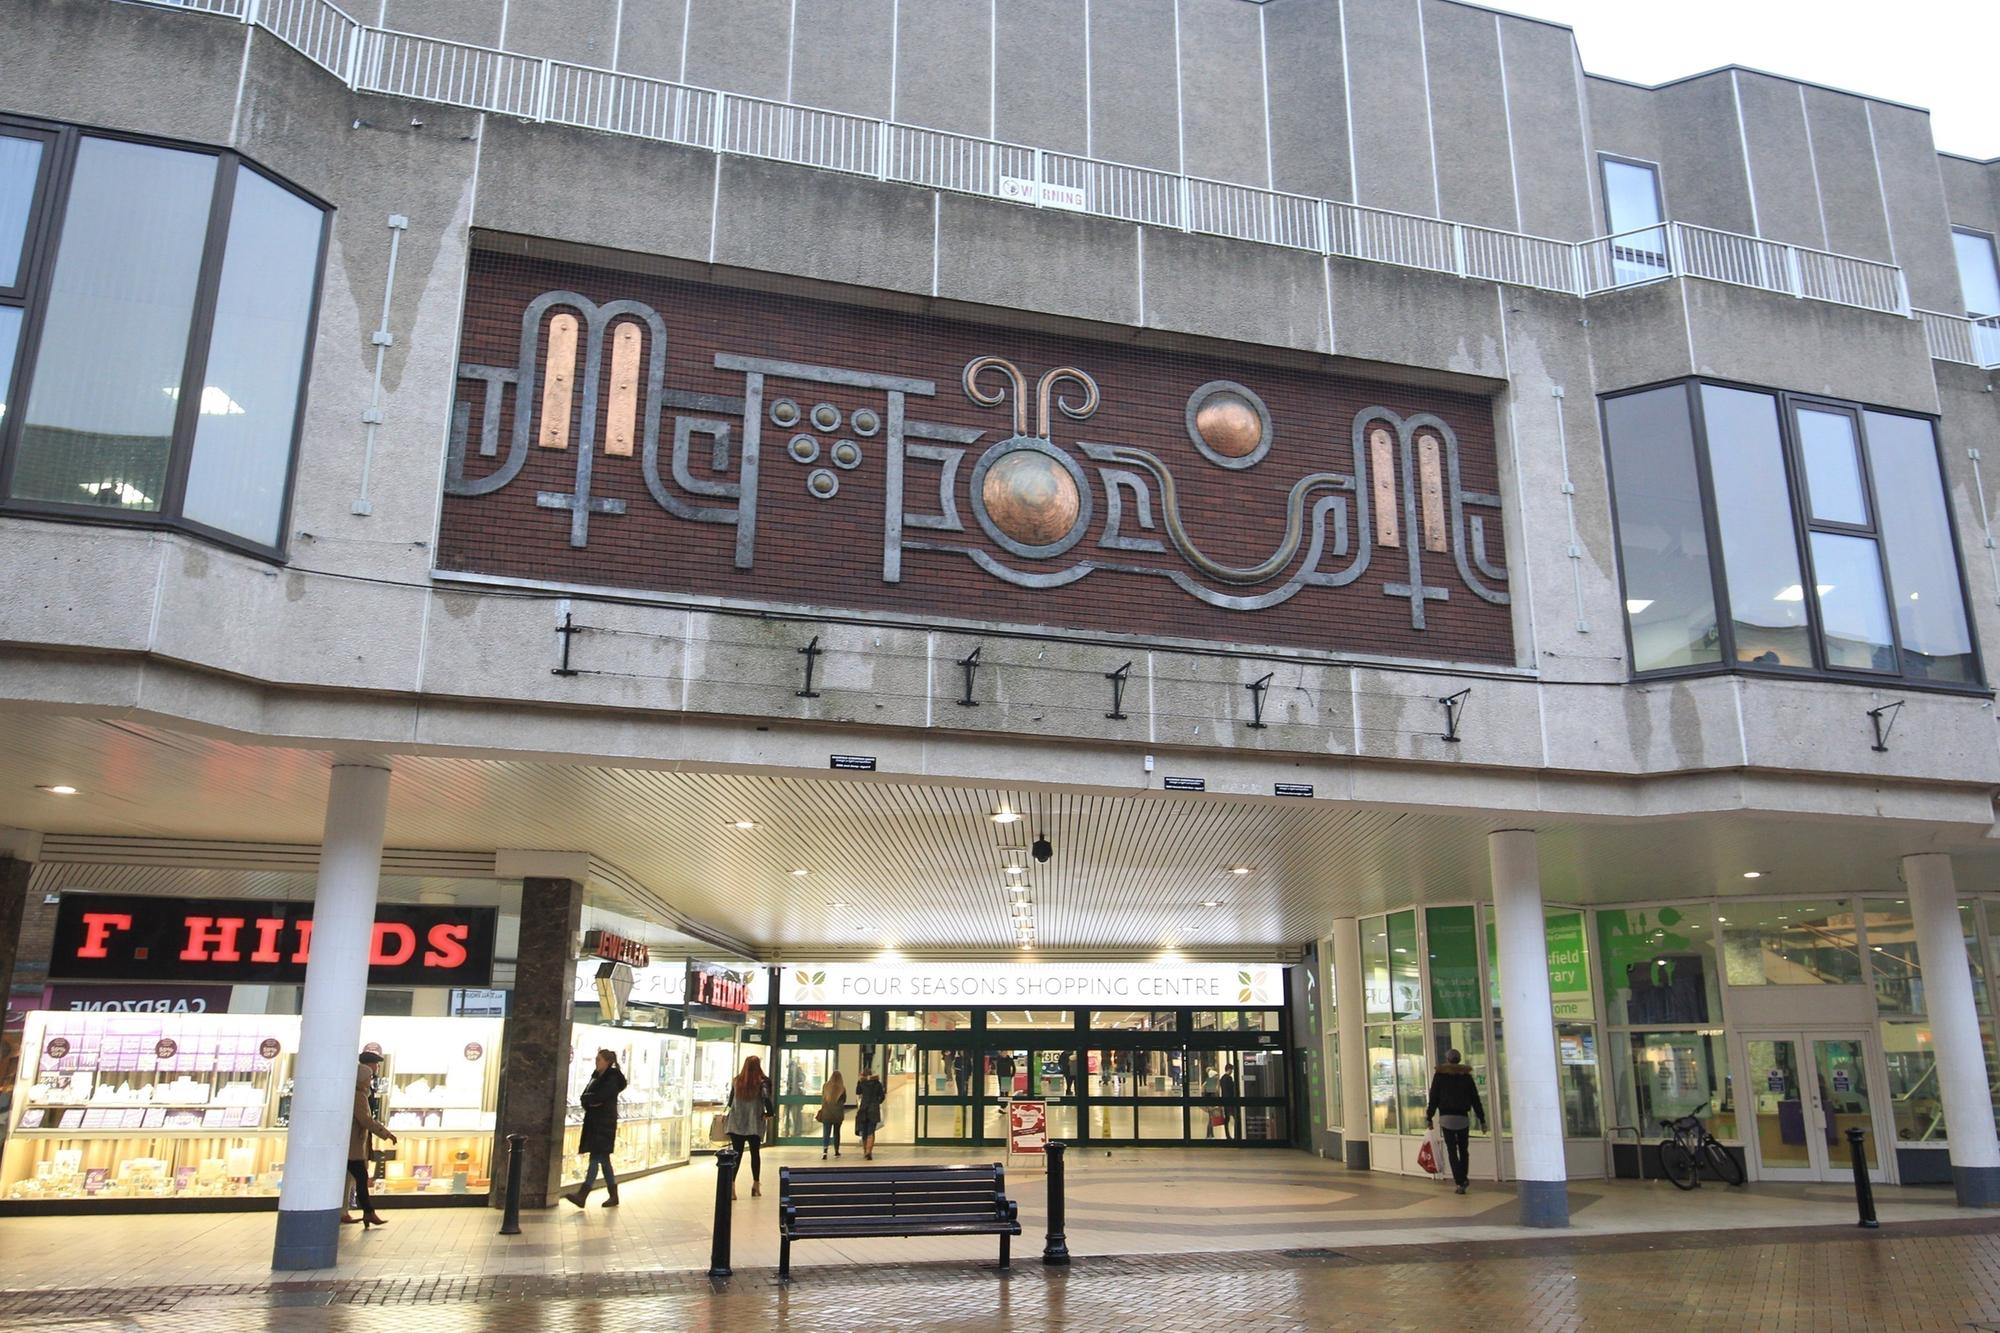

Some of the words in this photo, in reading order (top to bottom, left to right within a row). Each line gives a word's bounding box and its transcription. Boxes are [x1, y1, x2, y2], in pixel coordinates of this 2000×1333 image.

[1021, 185, 1082, 205] WRNING
[842, 977, 901, 995] FOUR
[911, 977, 1008, 995] SEASONS
[1016, 977, 1129, 996] SHOPPING
[1138, 977, 1220, 996] CENTRE
